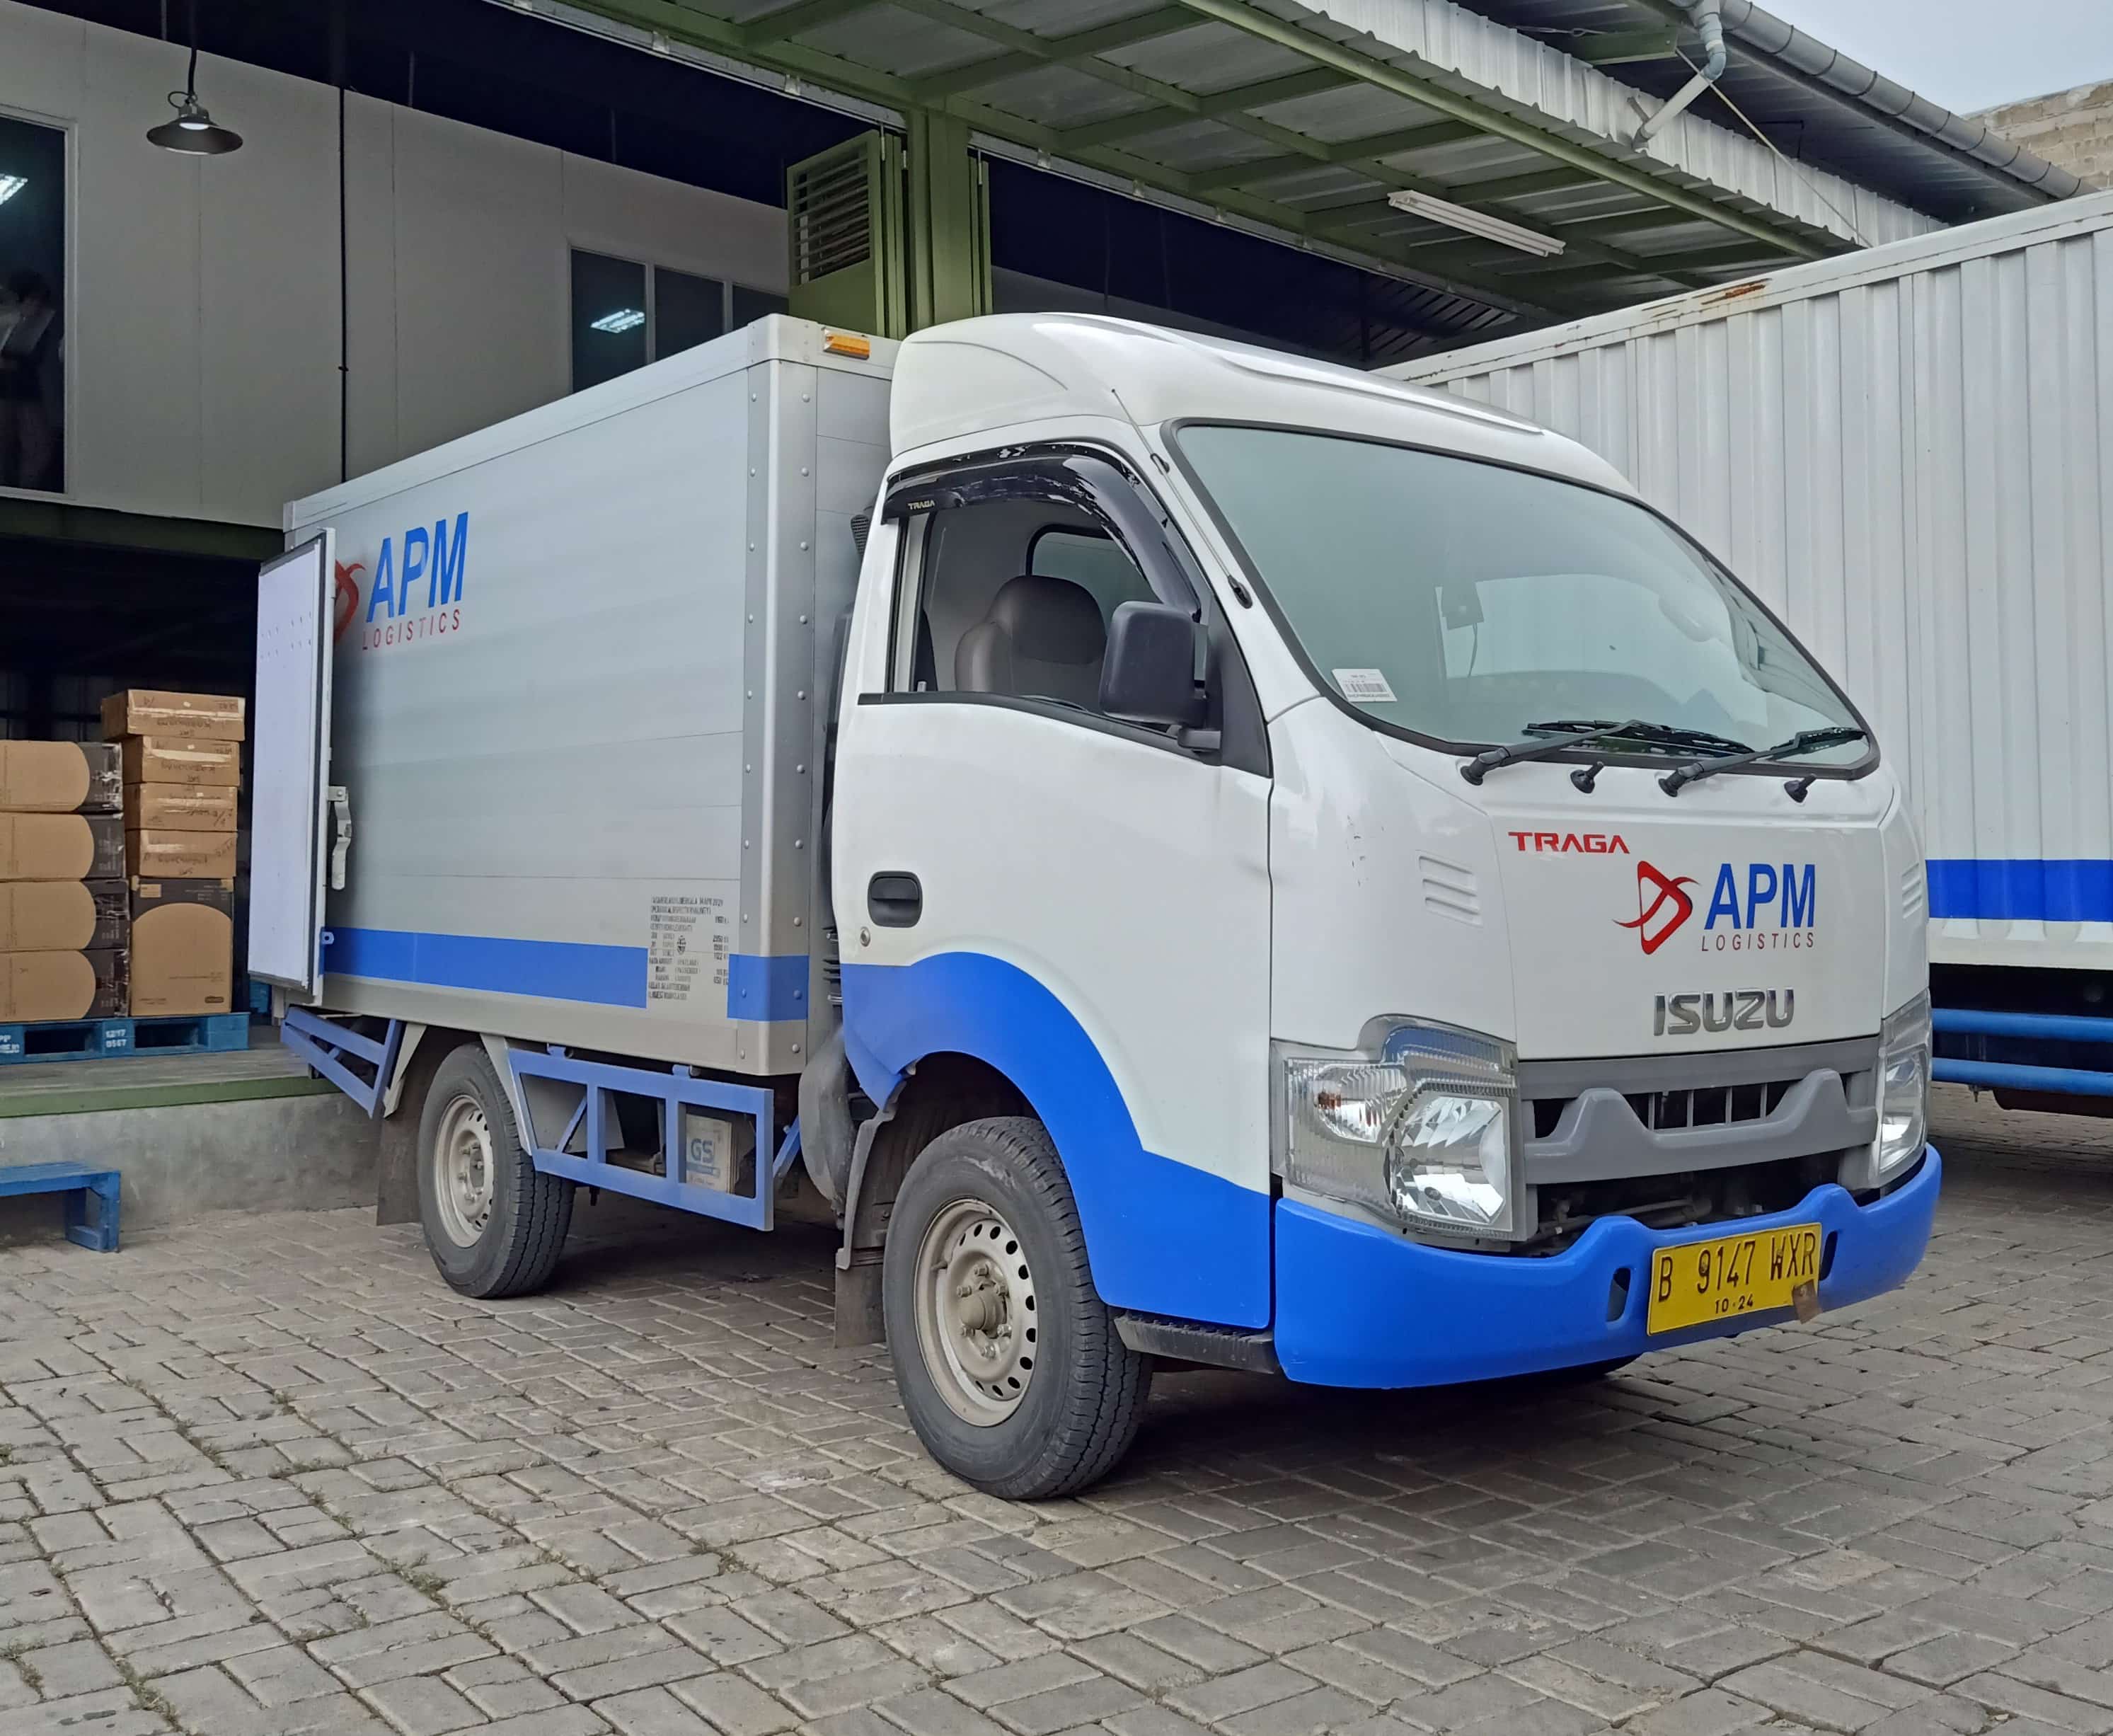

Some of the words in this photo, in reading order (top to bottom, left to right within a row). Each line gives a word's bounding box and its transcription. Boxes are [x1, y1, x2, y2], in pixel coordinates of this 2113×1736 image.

[365, 511, 468, 623] APM
[362, 609, 461, 650] LOGISTICS
[1508, 832, 1630, 853] TRAGA
[1703, 863, 1816, 930] APM
[1701, 932, 1814, 952] LOGISTICS
[1653, 988, 1794, 1037] ISUZU
[691, 1137, 715, 1164] GS
[1659, 1256, 1674, 1303] B
[1697, 1240, 1756, 1294] 9147
[1770, 1231, 1816, 1281] WXR
